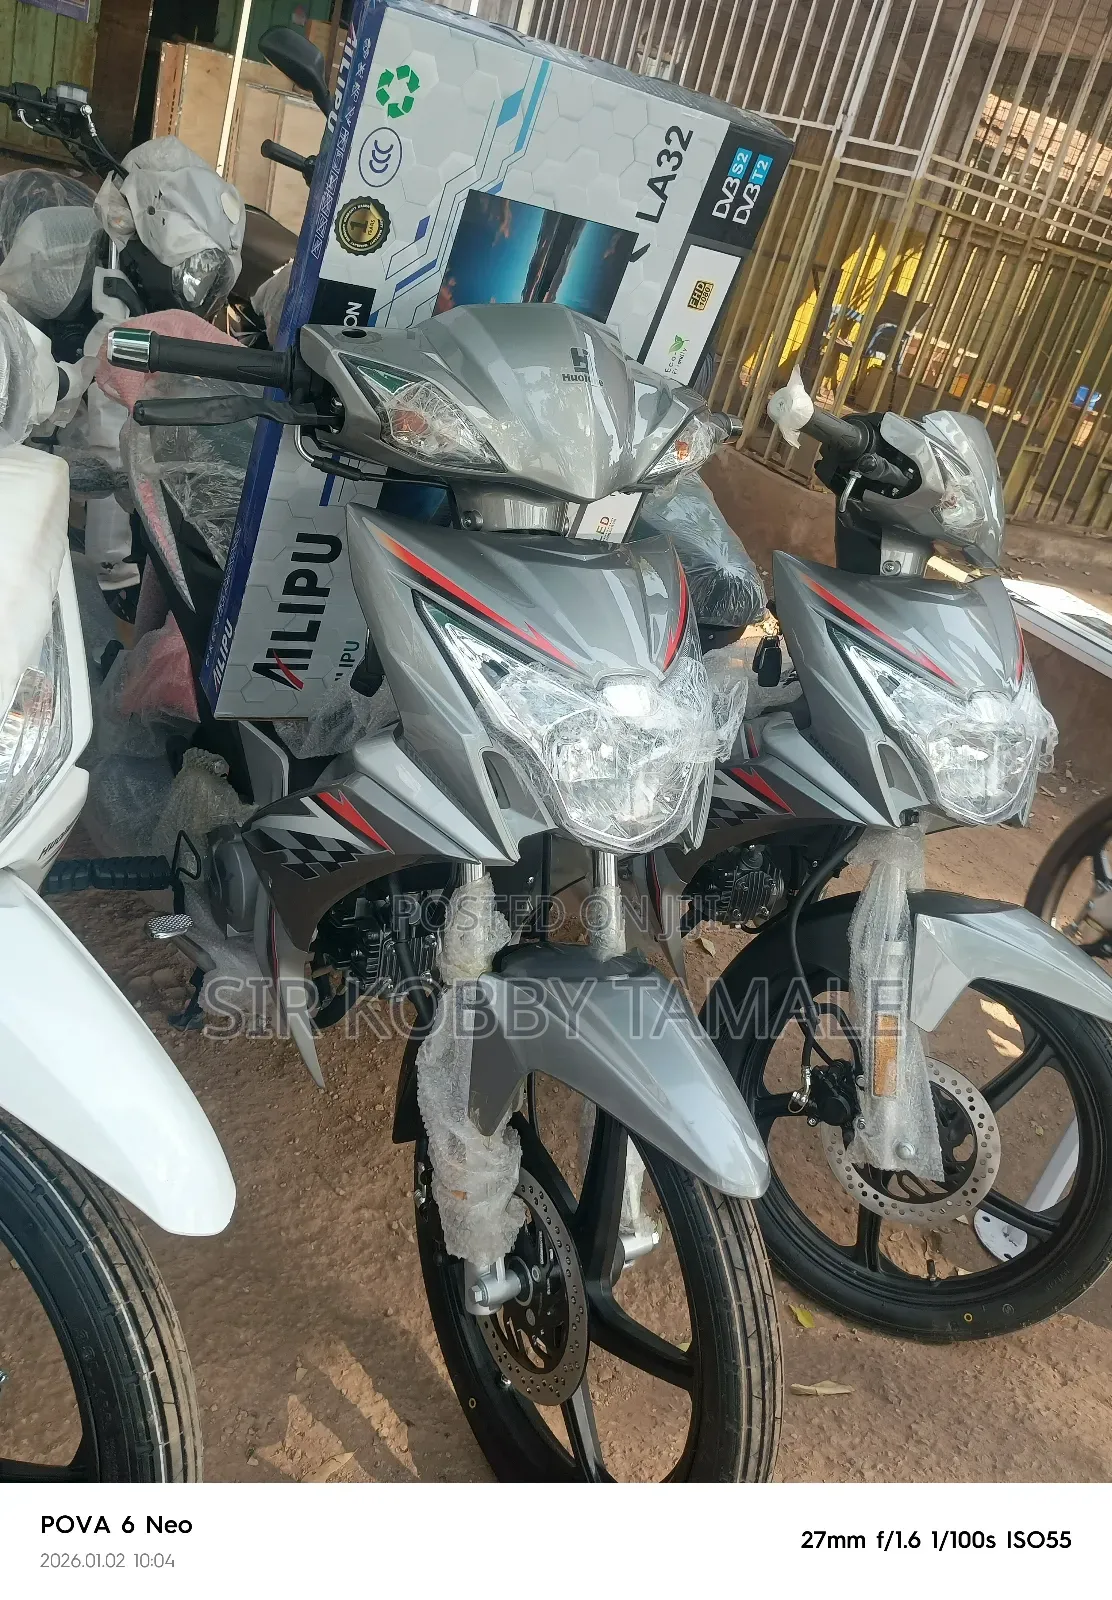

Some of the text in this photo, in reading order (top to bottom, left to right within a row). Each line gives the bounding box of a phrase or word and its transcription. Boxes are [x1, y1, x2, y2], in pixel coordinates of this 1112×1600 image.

[328, 21, 358, 134] AILIPU
[635, 125, 694, 223] LA32
[731, 152, 749, 175] S2
[751, 160, 769, 181] T2
[252, 532, 343, 692] AILIPU
[213, 618, 234, 693] AILIPU
